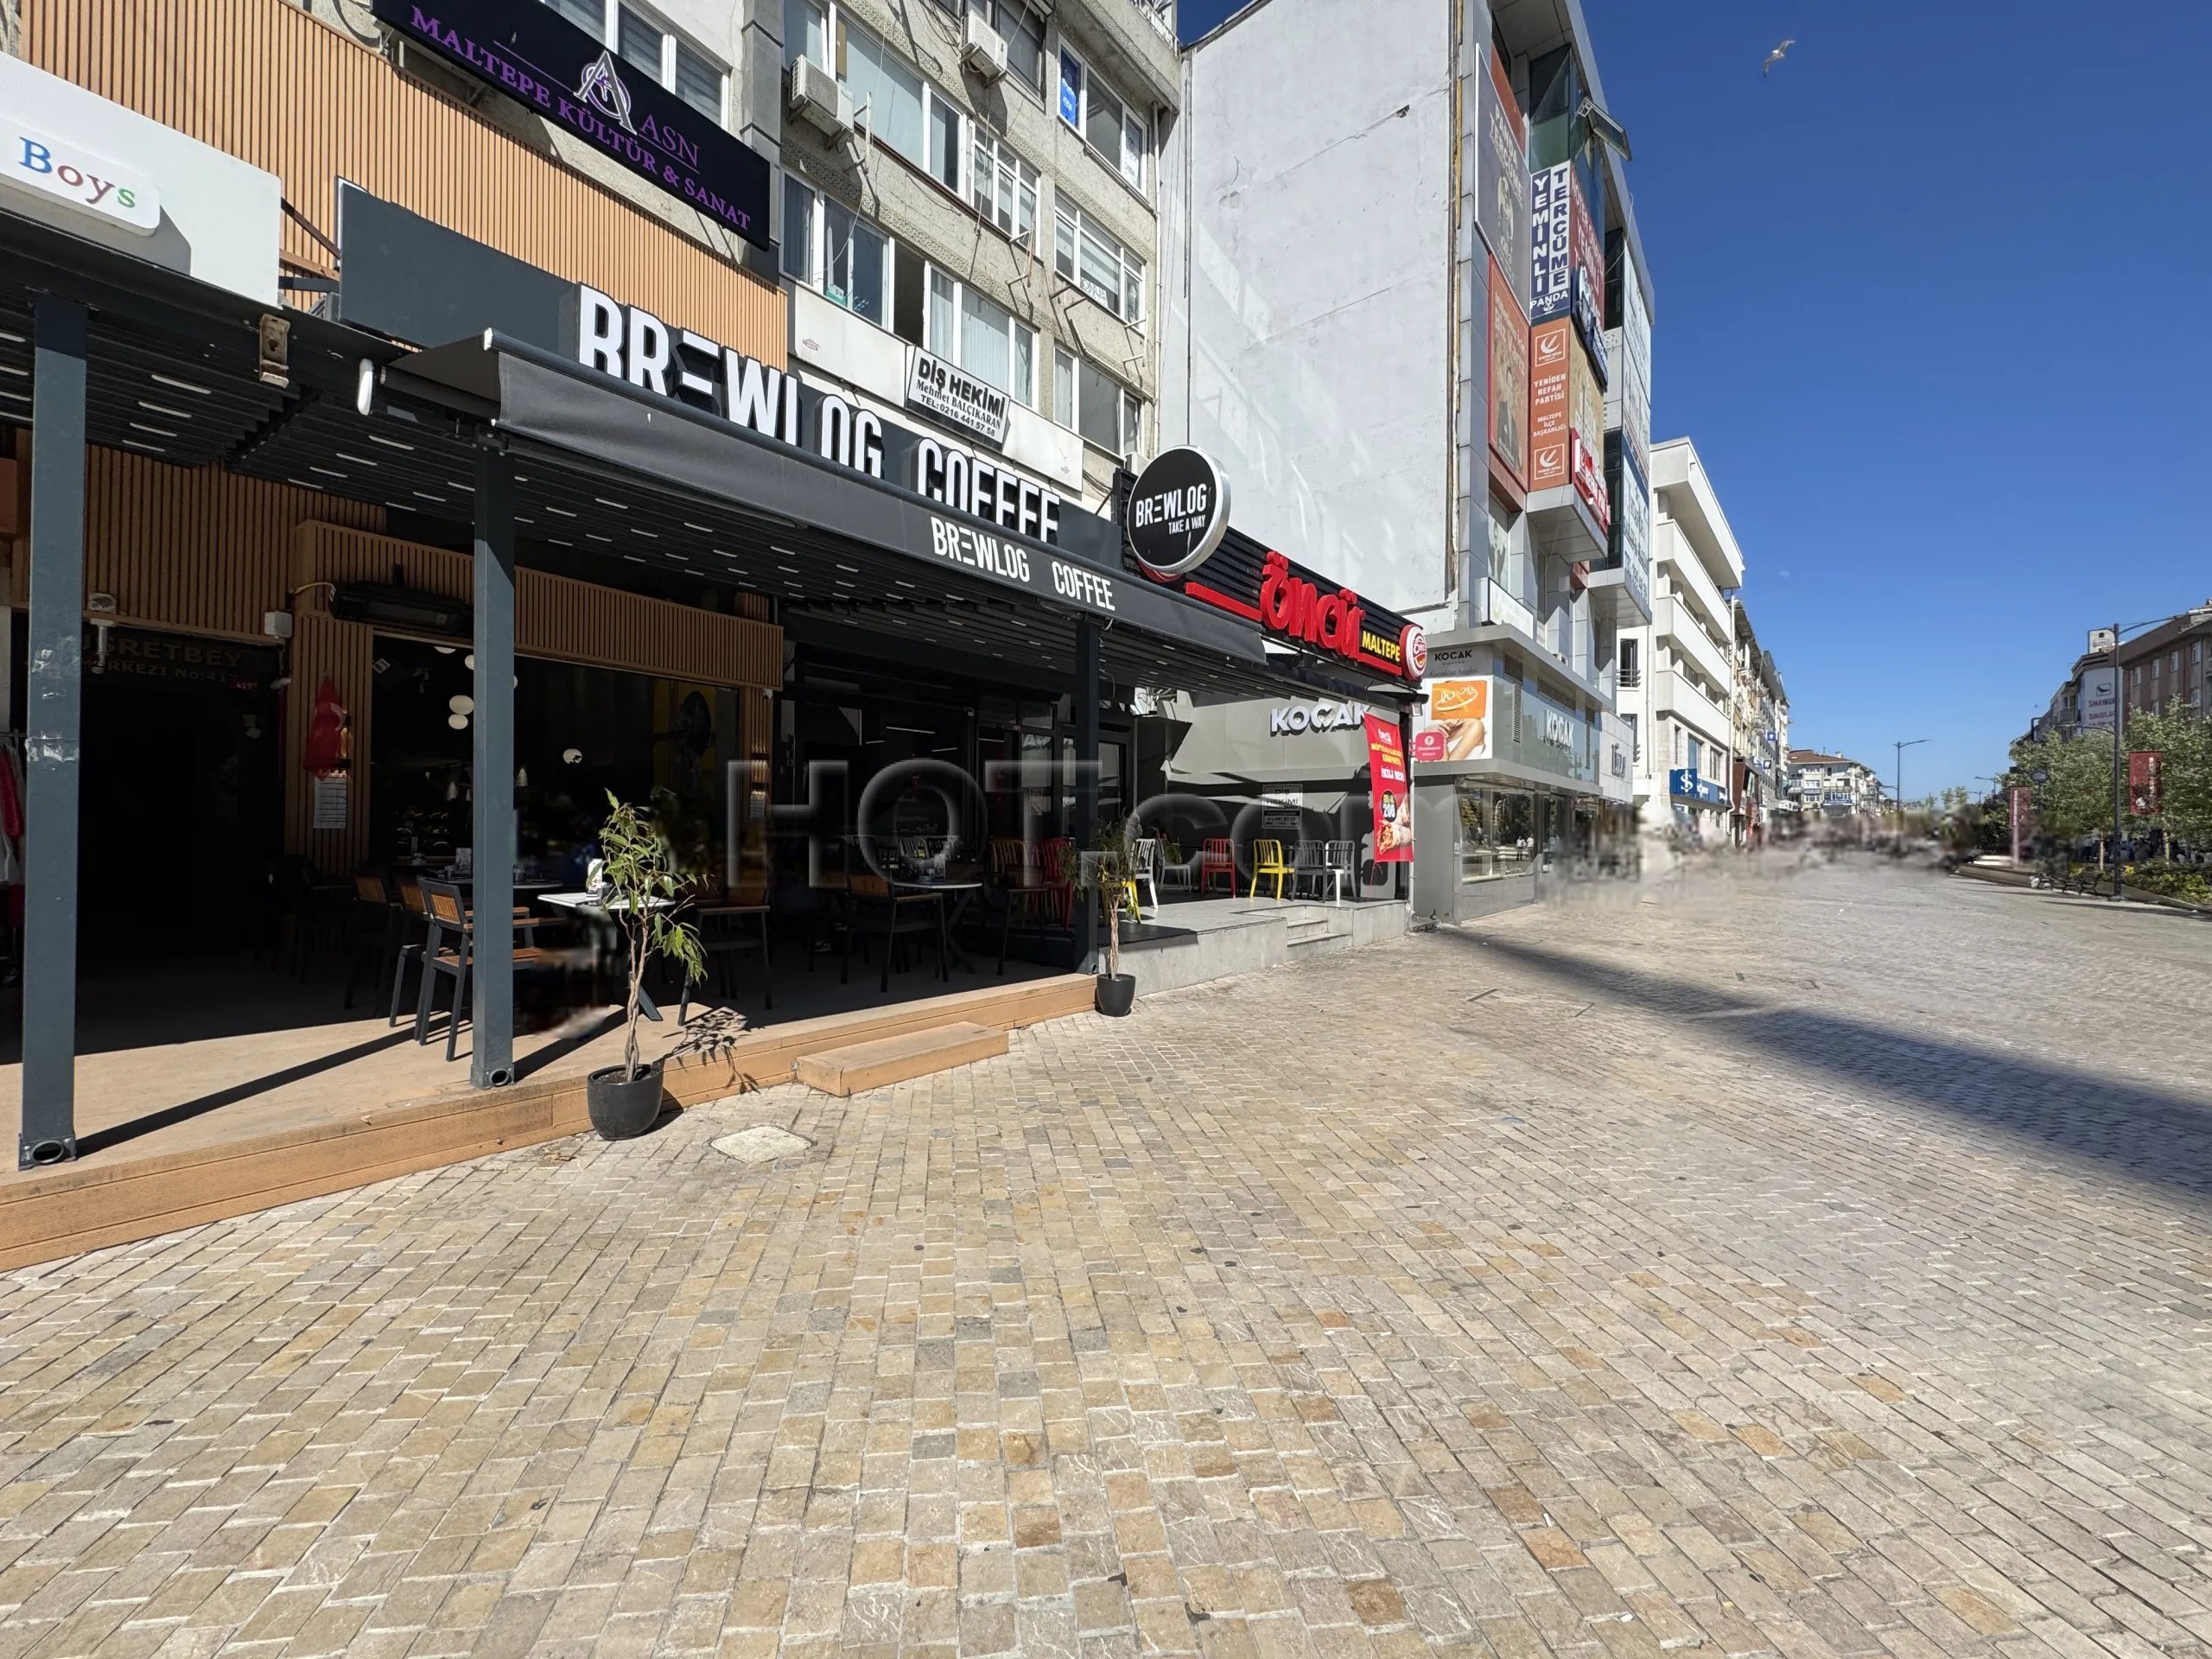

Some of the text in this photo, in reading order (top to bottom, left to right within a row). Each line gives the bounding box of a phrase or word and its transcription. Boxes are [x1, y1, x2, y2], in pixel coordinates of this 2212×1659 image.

[410, 5, 751, 231] MALTEPE KÜLTÜR & SANAT
[639, 114, 700, 168] ASN
[19, 136, 137, 209] Boys
[1532, 175, 1548, 292] YEMİNLİ
[1551, 168, 1568, 286] TERCÜME
[1530, 289, 1568, 309] PANDA
[918, 357, 1006, 421] DİŞ HEKİMİ
[1534, 373, 1566, 388] YENİDEN
[1535, 391, 1564, 405] PARTİSİ
[1538, 383, 1561, 396] REFAH
[916, 379, 1001, 429] Mehmet BALÇIKARAN
[961, 415, 974, 427] 441
[976, 422, 985, 431] 57
[1537, 411, 1562, 423] MALTEPE
[1136, 484, 1207, 528] BREWLOG
[1168, 515, 1206, 535] TAKE A WAY
[931, 516, 1116, 611] BREWLOG COFFEE
[1362, 631, 1401, 662] MALTEPE
